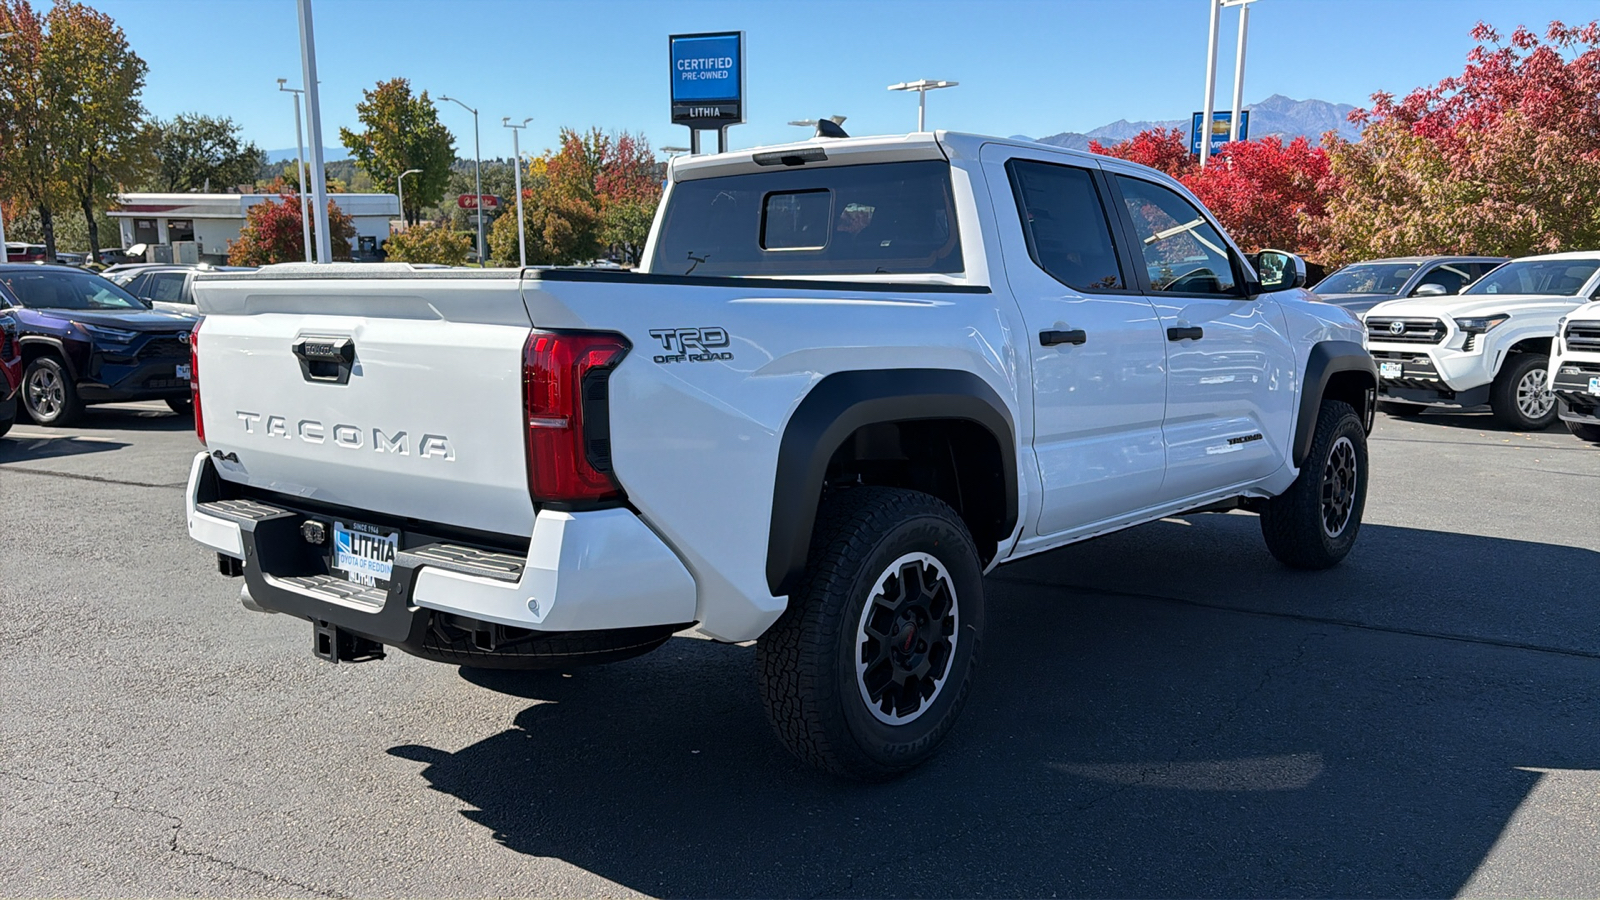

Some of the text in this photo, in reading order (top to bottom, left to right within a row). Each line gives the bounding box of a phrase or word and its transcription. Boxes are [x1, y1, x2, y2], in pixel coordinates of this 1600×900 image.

[677, 57, 733, 70] CERTIFIED
[682, 70, 729, 80] PRE-OWNED
[689, 107, 720, 117] LITHIA
[649, 327, 730, 355] TRD
[305, 344, 334, 355] TOYOTA
[653, 352, 734, 363] OFF ROAD
[236, 411, 456, 461] TACOMA
[1227, 433, 1263, 445] TACOMA
[353, 522, 379, 534] SINCE 1946
[350, 532, 395, 563] LITHIA
[340, 554, 392, 574] OYOTA OF REDDIN
